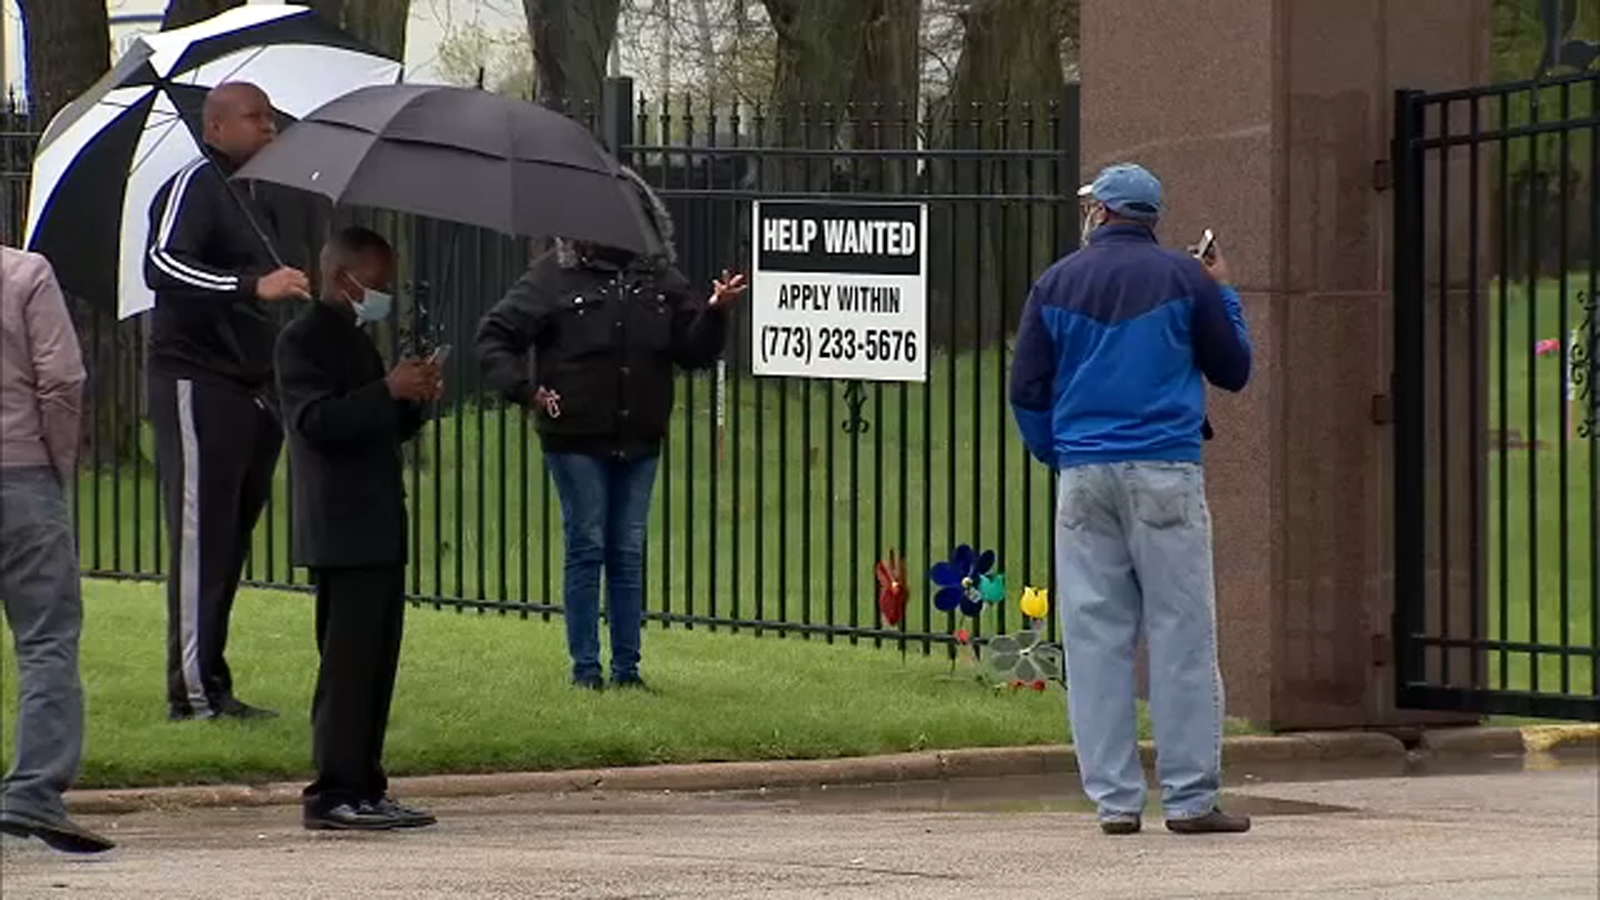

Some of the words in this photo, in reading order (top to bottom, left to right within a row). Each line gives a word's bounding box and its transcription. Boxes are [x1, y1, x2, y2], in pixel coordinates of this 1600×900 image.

[763, 217, 818, 253] HELP
[823, 219, 916, 256] WANTED
[778, 284, 832, 310] APPLY
[837, 285, 900, 313] WITHIN
[761, 325, 812, 364] (773)
[819, 328, 917, 363] 233-5676
